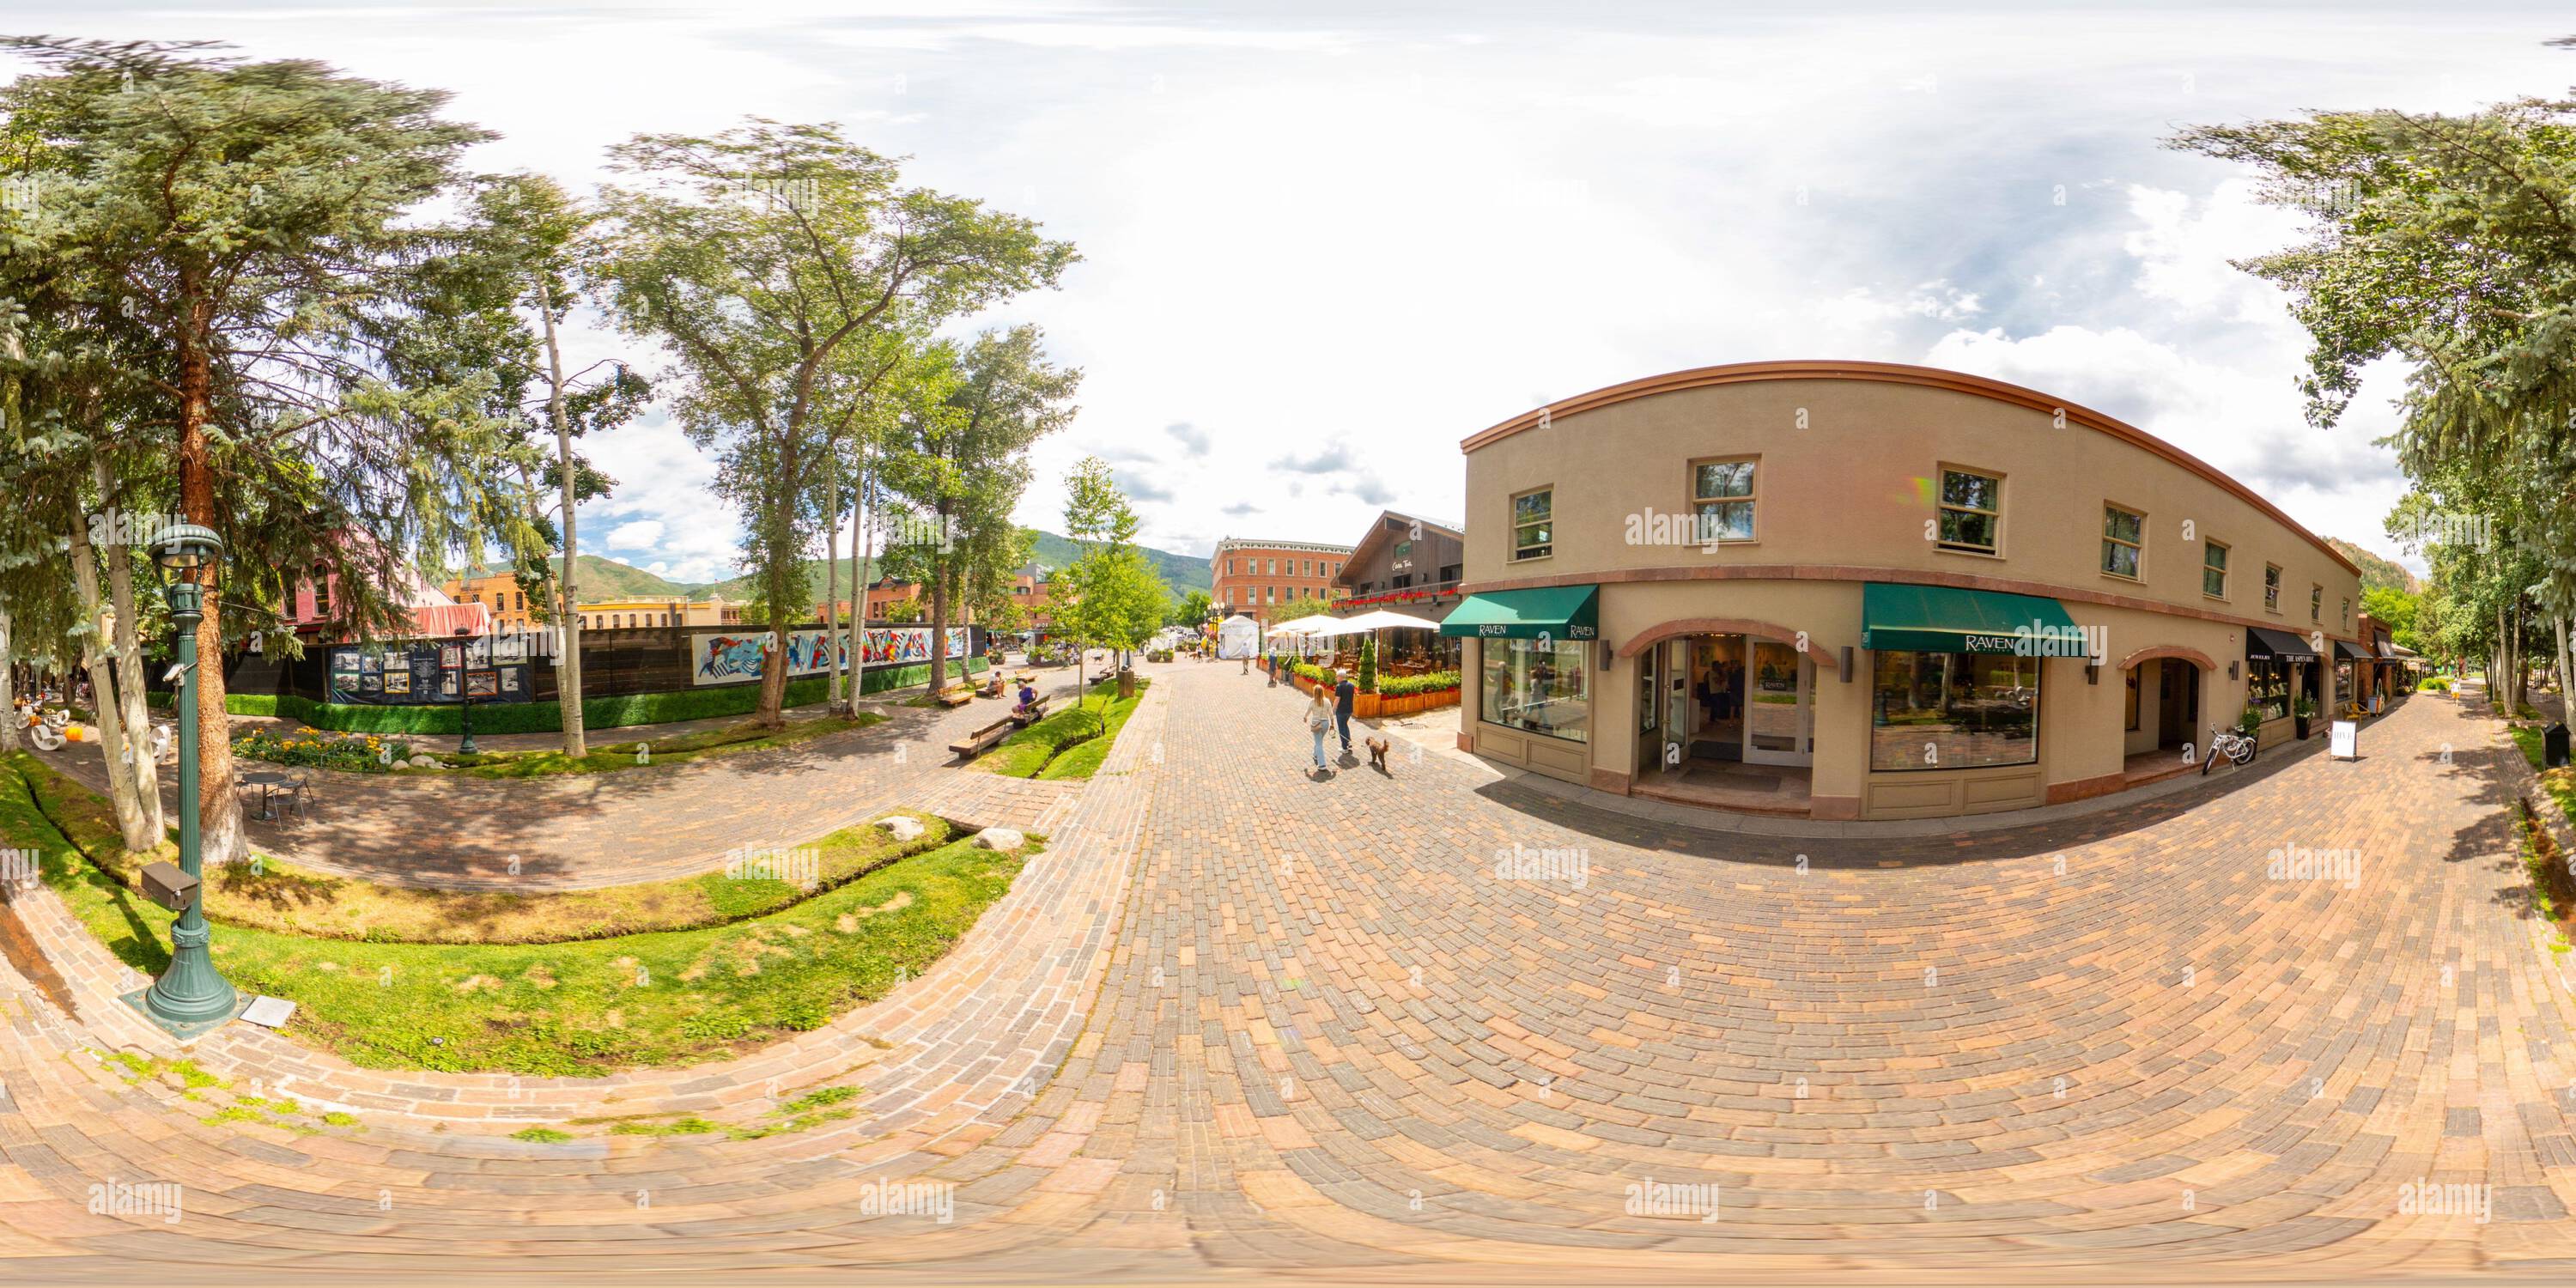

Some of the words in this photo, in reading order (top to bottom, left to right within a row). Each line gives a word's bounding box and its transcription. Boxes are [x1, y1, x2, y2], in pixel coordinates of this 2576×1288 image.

[1479, 624, 1506, 636] RAVEN
[1571, 624, 1595, 639] RAVEN
[1965, 635, 2014, 652] RAVEN
